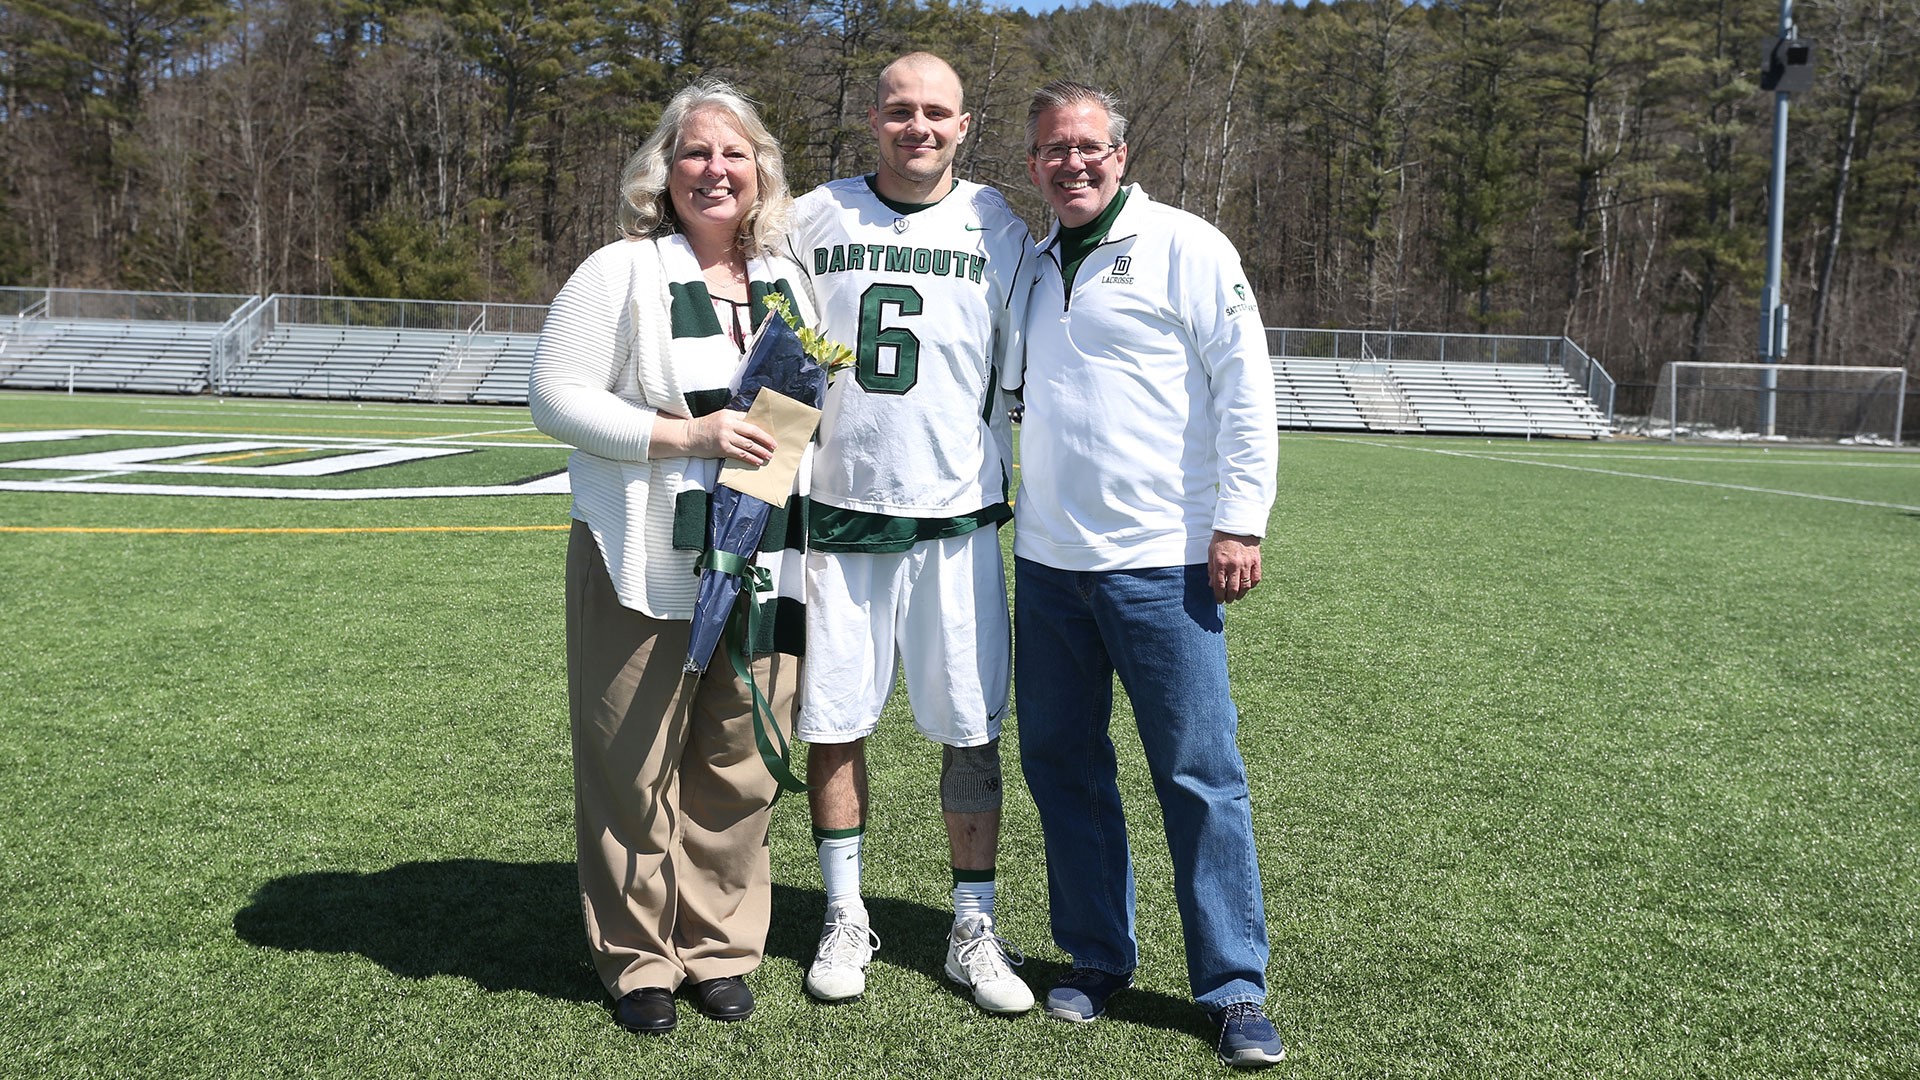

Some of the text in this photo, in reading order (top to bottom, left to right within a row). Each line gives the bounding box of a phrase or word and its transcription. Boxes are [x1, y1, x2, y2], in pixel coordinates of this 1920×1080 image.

[813, 243, 987, 285] DARTMOUTH
[1111, 255, 1132, 275] D
[1101, 276, 1134, 285] LACROSSE
[855, 282, 924, 396] 6
